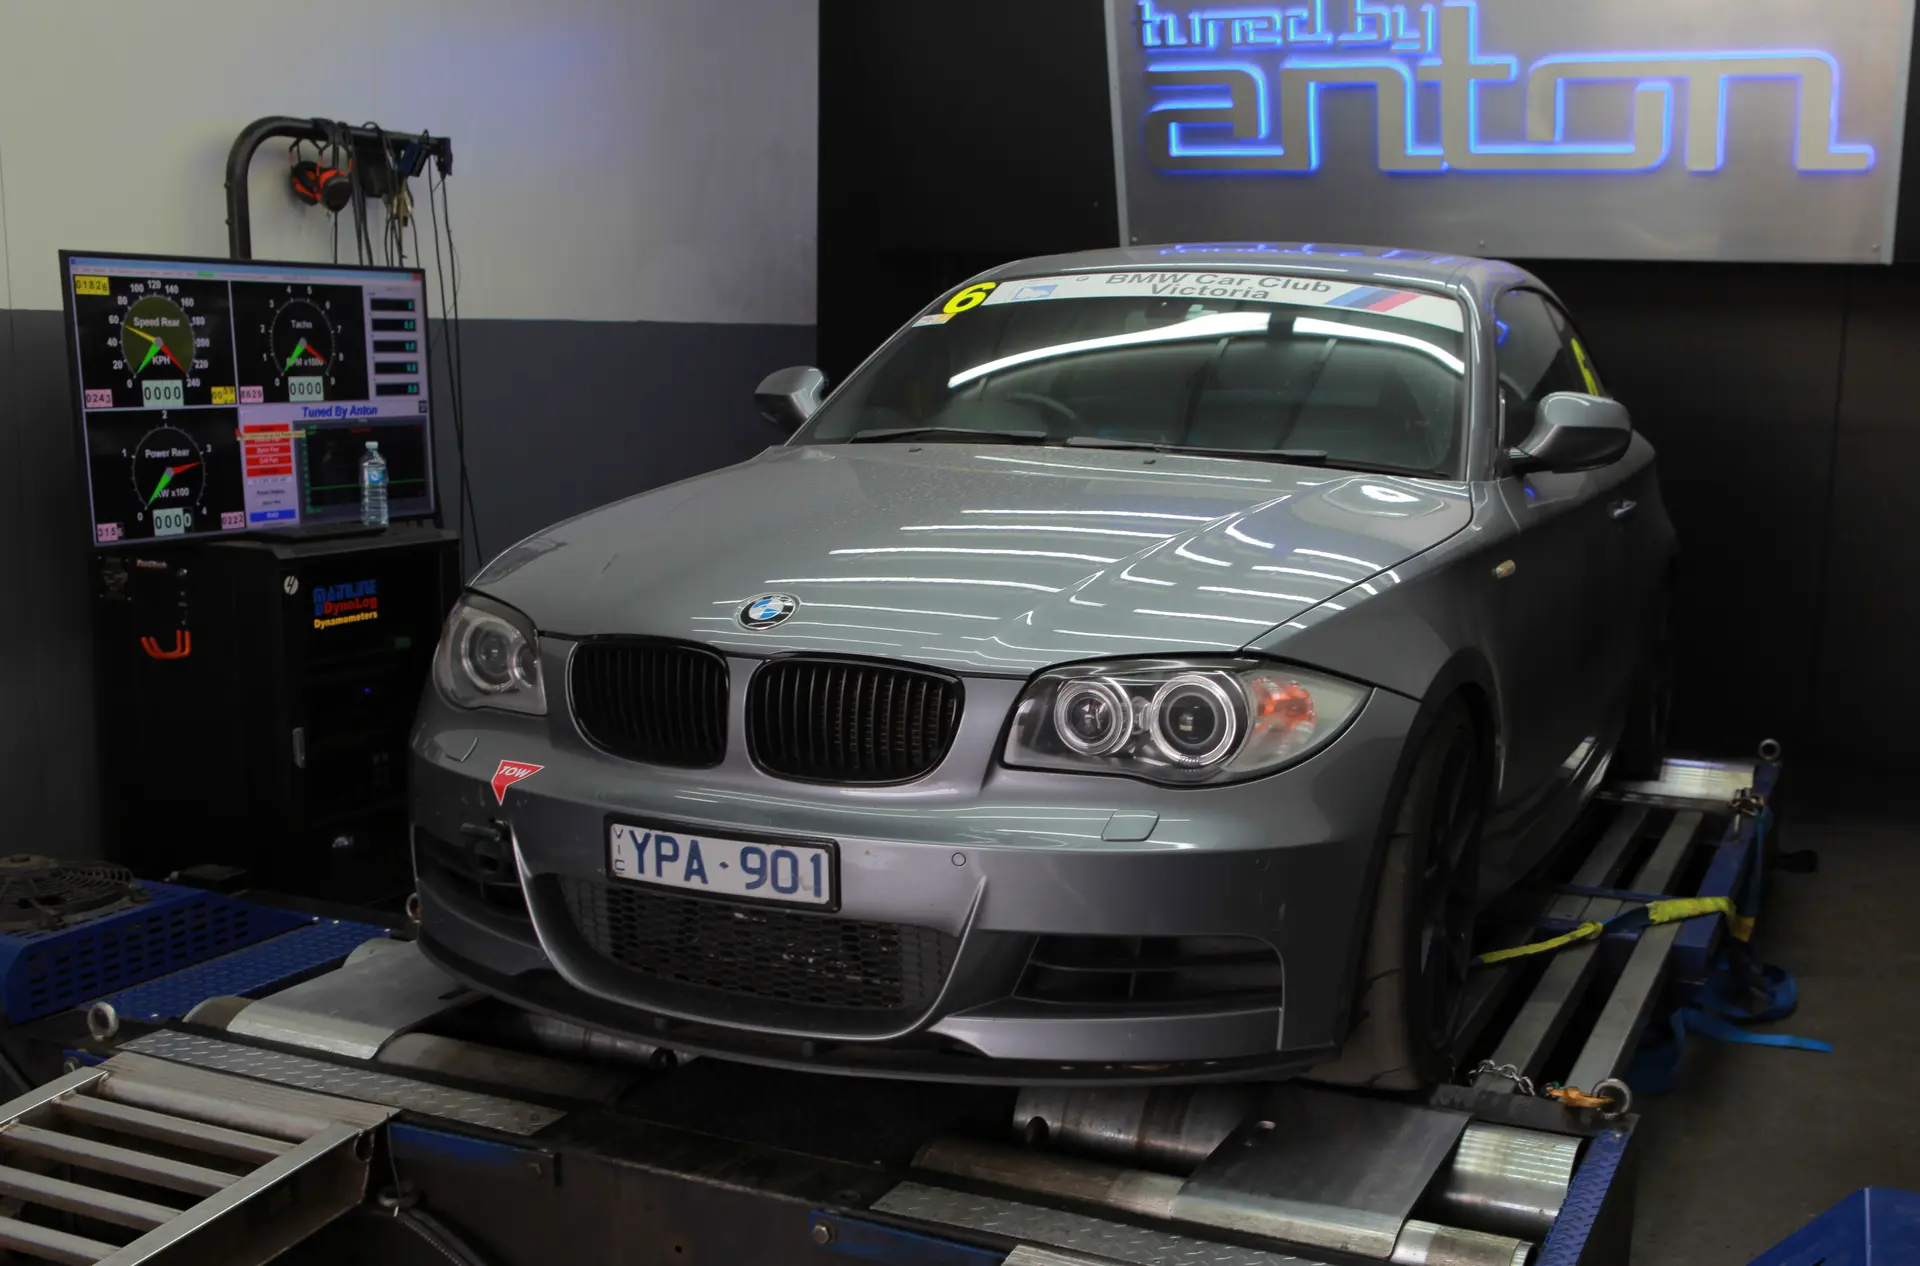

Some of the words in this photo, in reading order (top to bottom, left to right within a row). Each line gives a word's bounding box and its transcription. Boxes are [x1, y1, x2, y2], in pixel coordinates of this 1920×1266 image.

[1337, 0, 1436, 52] by
[1145, 1, 1876, 172] anton
[130, 283, 144, 293] 100
[148, 280, 161, 289] 120
[1105, 273, 1190, 285] BMW
[1195, 273, 1250, 287] Car
[1258, 276, 1331, 293] Club
[165, 284, 179, 294] 140
[286, 285, 292, 294] 4
[1151, 283, 1270, 299] Victoria
[117, 296, 128, 305] 80
[943, 281, 997, 314] 6
[181, 298, 194, 308] 160
[109, 315, 120, 325] 60
[133, 316, 159, 328] Speed
[161, 317, 181, 327] Rear
[192, 316, 205, 326] 180
[291, 319, 313, 329] Tacho
[260, 325, 266, 333] 2
[337, 325, 342, 334] 7
[107, 338, 118, 347] 40
[196, 338, 210, 347] 200
[152, 355, 171, 365] KPH
[262, 353, 268, 362] 1
[113, 360, 123, 369] 20
[195, 359, 209, 369] 220
[127, 379, 133, 388] 0
[186, 378, 201, 387] 240
[274, 378, 280, 387] 0
[144, 386, 181, 400] 0000
[290, 382, 322, 396] 0000
[162, 411, 168, 419] 2
[302, 406, 332, 418] Tuned
[335, 405, 348, 419] By
[350, 404, 378, 417] Anton
[122, 448, 127, 458] 1
[145, 449, 169, 459] Power
[171, 448, 190, 457] Rear
[206, 444, 212, 453] 3
[171, 487, 189, 498] x100
[202, 506, 208, 515] 4
[137, 512, 143, 521] 0
[155, 513, 192, 530] 0000
[323, 596, 378, 616] DynoLog
[313, 611, 378, 630] Dynamometers
[498, 765, 532, 778] TOW
